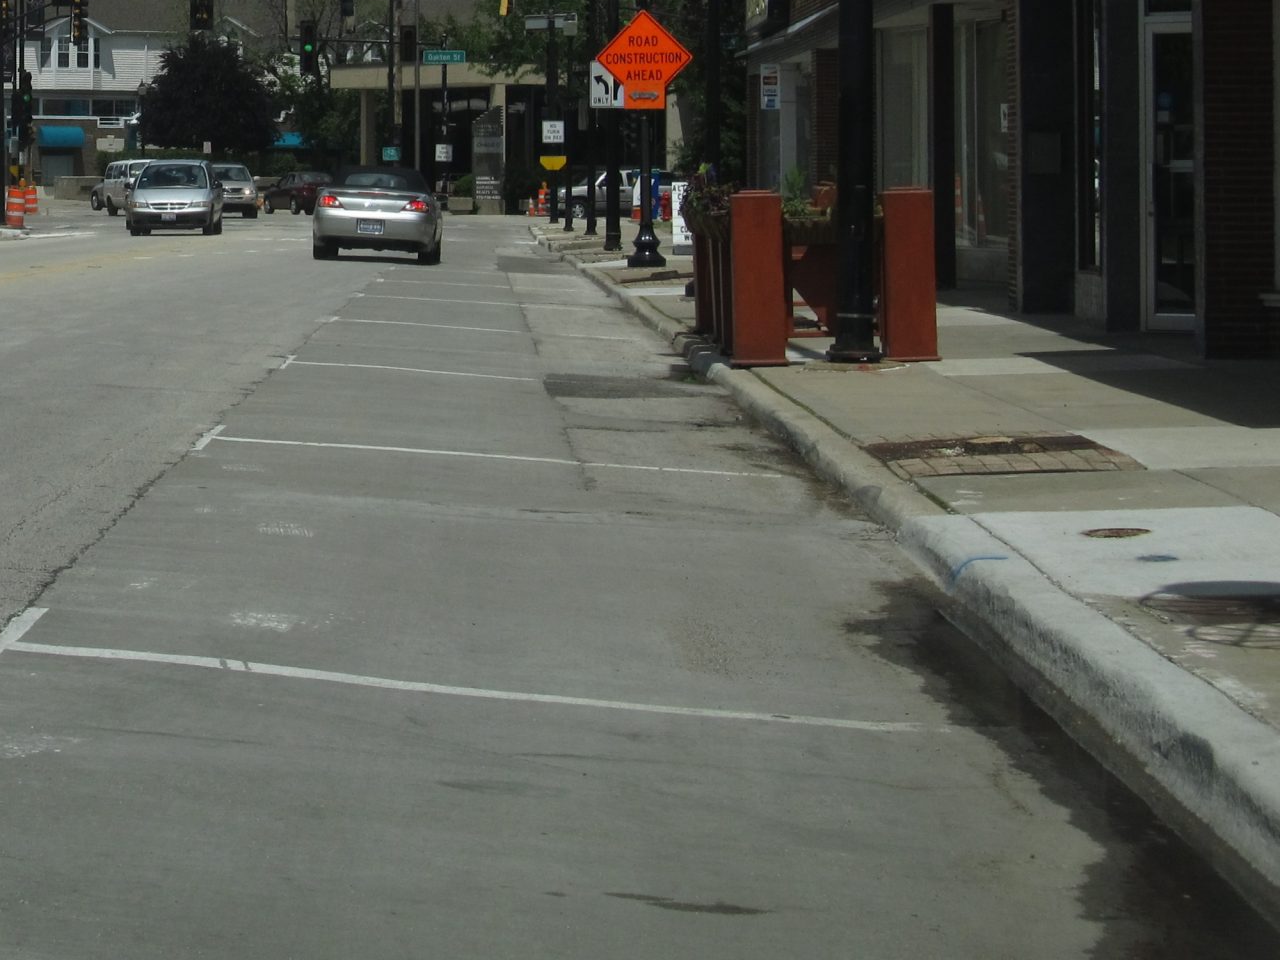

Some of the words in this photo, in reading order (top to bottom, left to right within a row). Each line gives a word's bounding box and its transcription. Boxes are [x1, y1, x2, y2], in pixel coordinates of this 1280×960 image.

[628, 36, 658, 47] ROAD
[605, 52, 682, 65] CONSTRUCTION
[626, 70, 663, 81] AHEAD
